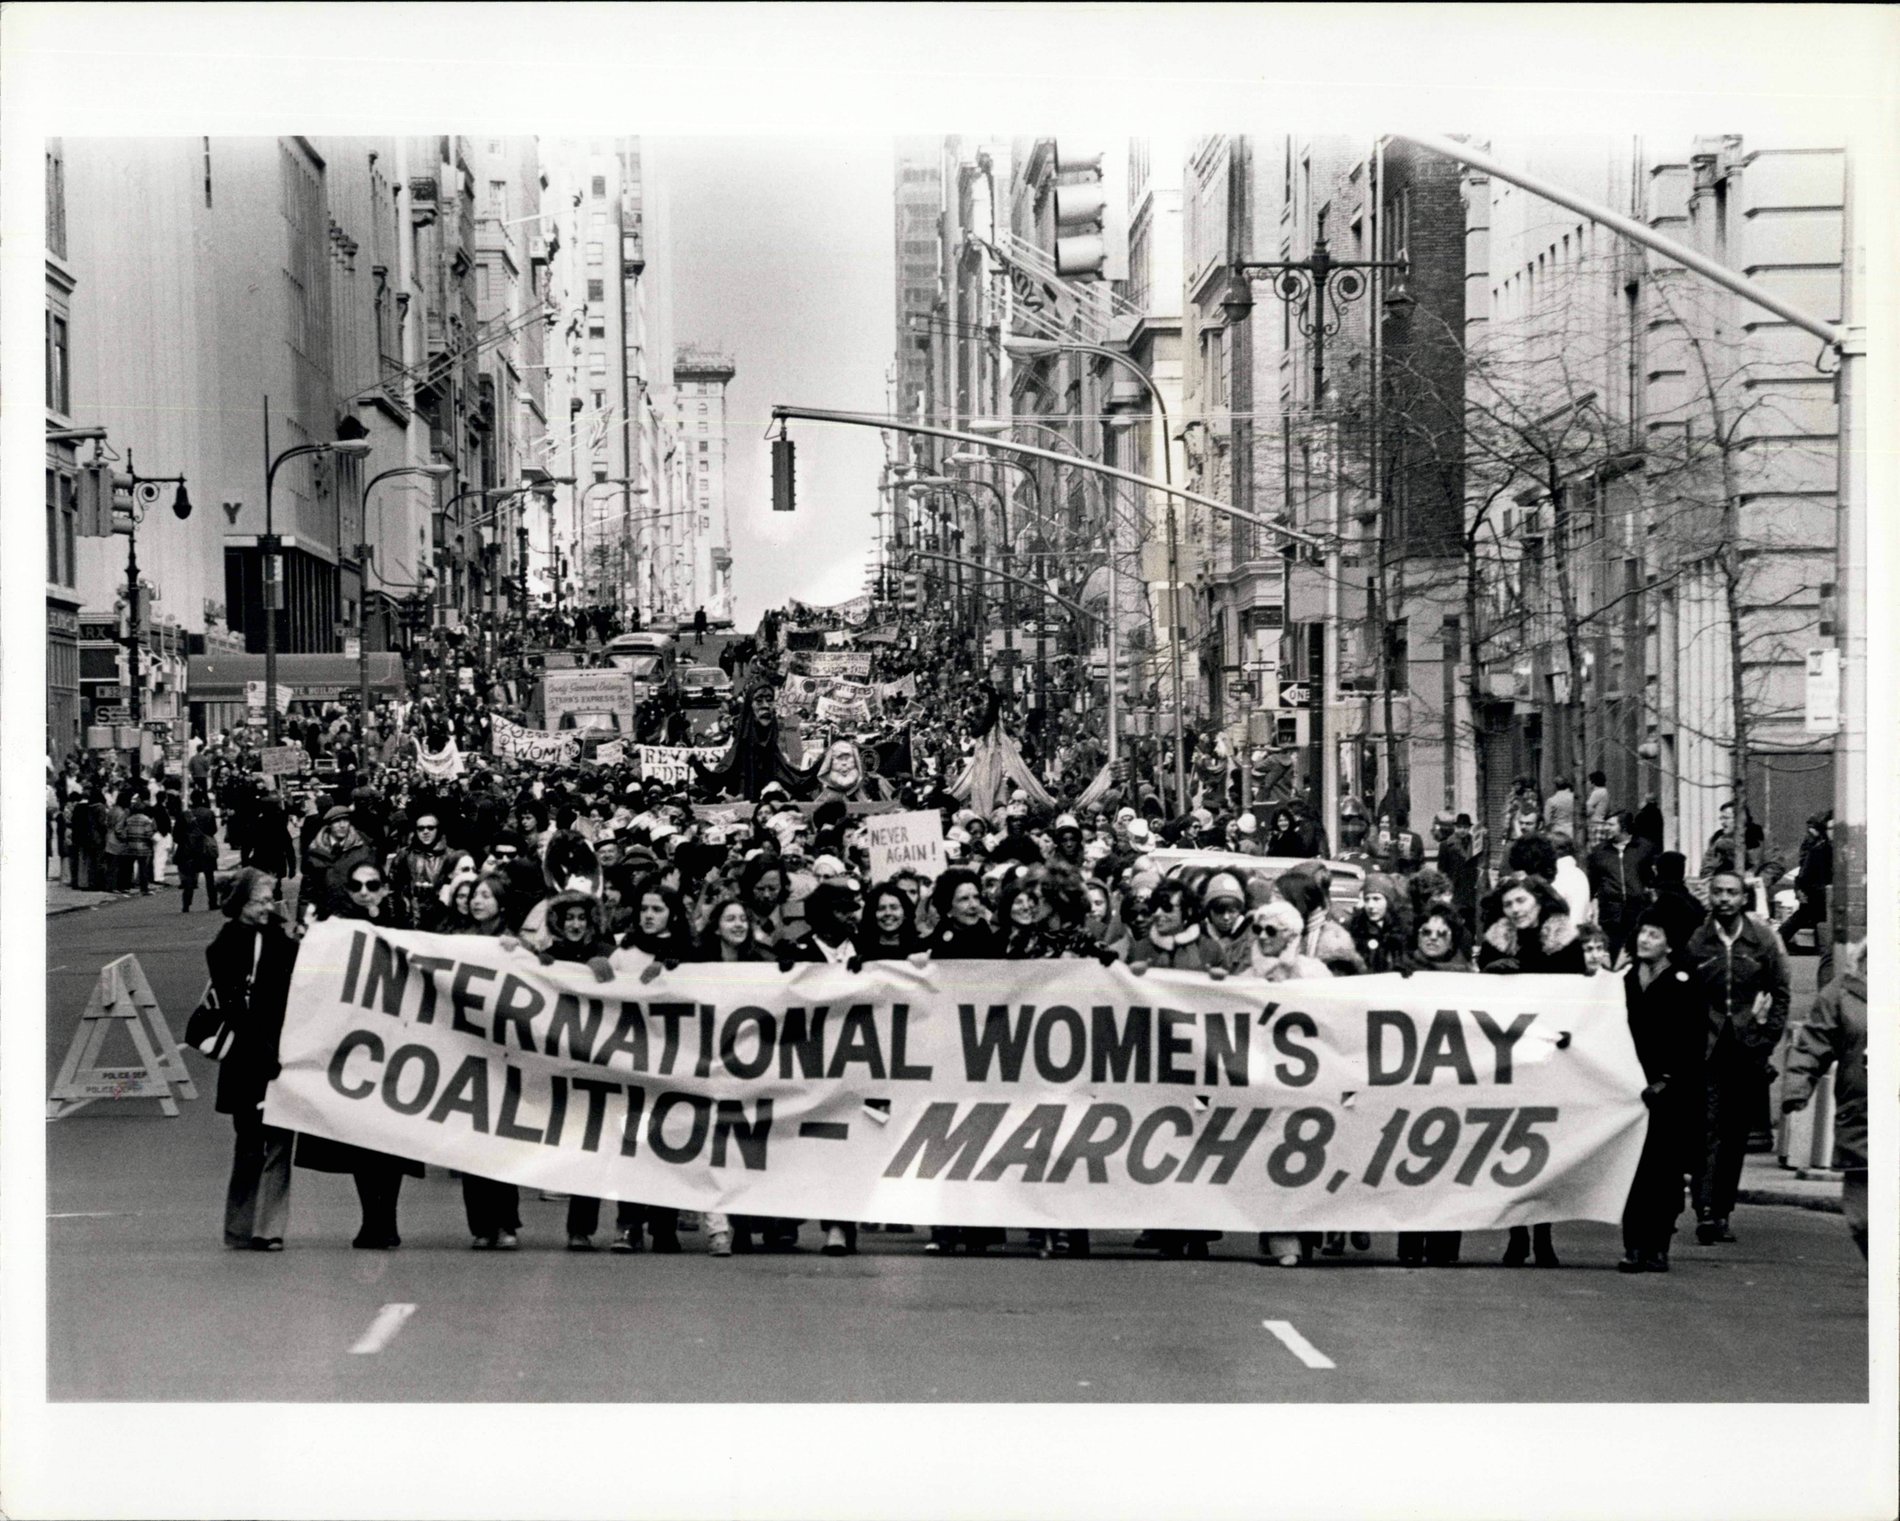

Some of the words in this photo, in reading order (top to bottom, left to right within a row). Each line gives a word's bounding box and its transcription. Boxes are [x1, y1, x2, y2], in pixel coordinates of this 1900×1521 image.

[222, 502, 242, 524] Y
[1289, 689, 1311, 701] ONE
[97, 706, 111, 724] S
[871, 826, 910, 847] NEVER
[341, 930, 933, 1080] INTERNATIONAL
[957, 1001, 1320, 1087] WOMEN'S
[1366, 1010, 1538, 1086] DAY
[327, 1029, 773, 1171] COALITION
[883, 1102, 1272, 1186] MARCH
